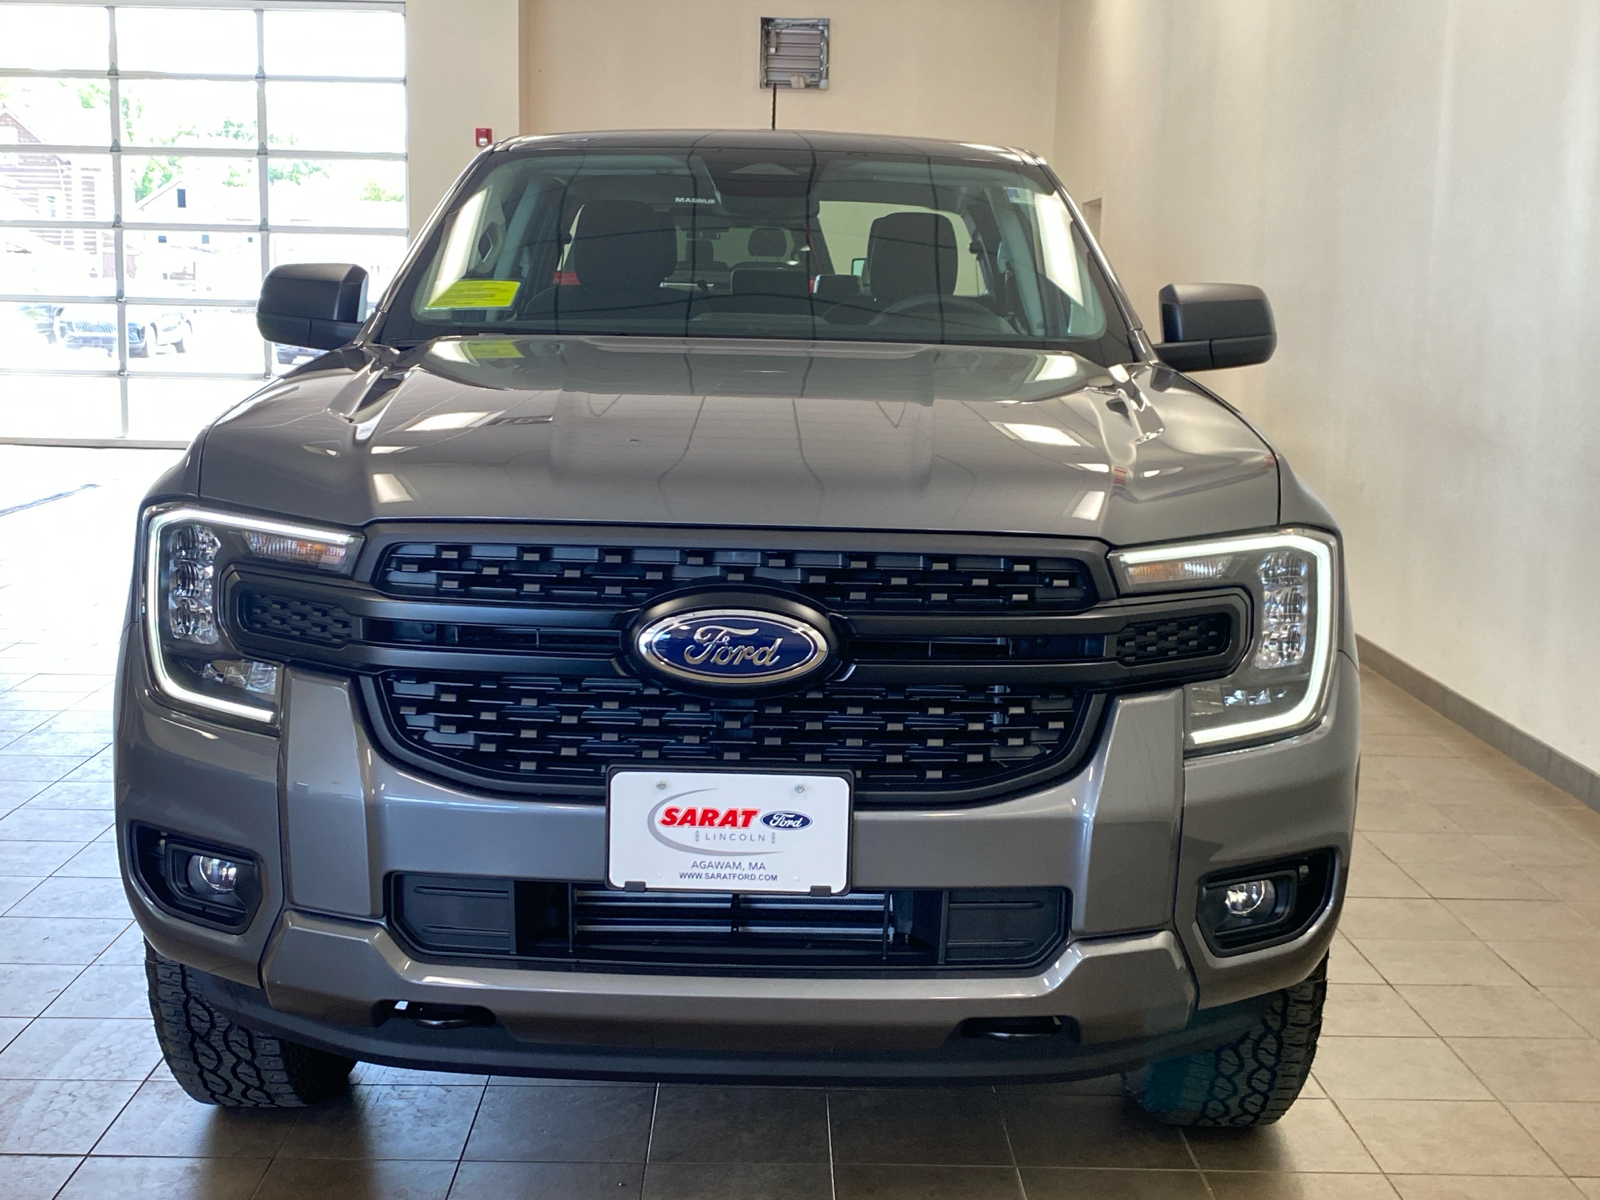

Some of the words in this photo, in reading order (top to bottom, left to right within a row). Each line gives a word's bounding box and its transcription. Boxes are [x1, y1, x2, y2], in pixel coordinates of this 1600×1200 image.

[684, 625, 783, 667] Ford
[660, 807, 759, 828] SARAT
[769, 812, 803, 828] Ford
[705, 833, 766, 842] LINCOLN
[691, 860, 746, 871] AGAWAM,
[748, 862, 766, 870] MA
[679, 872, 778, 881] WWW.SARATFORD.COM
